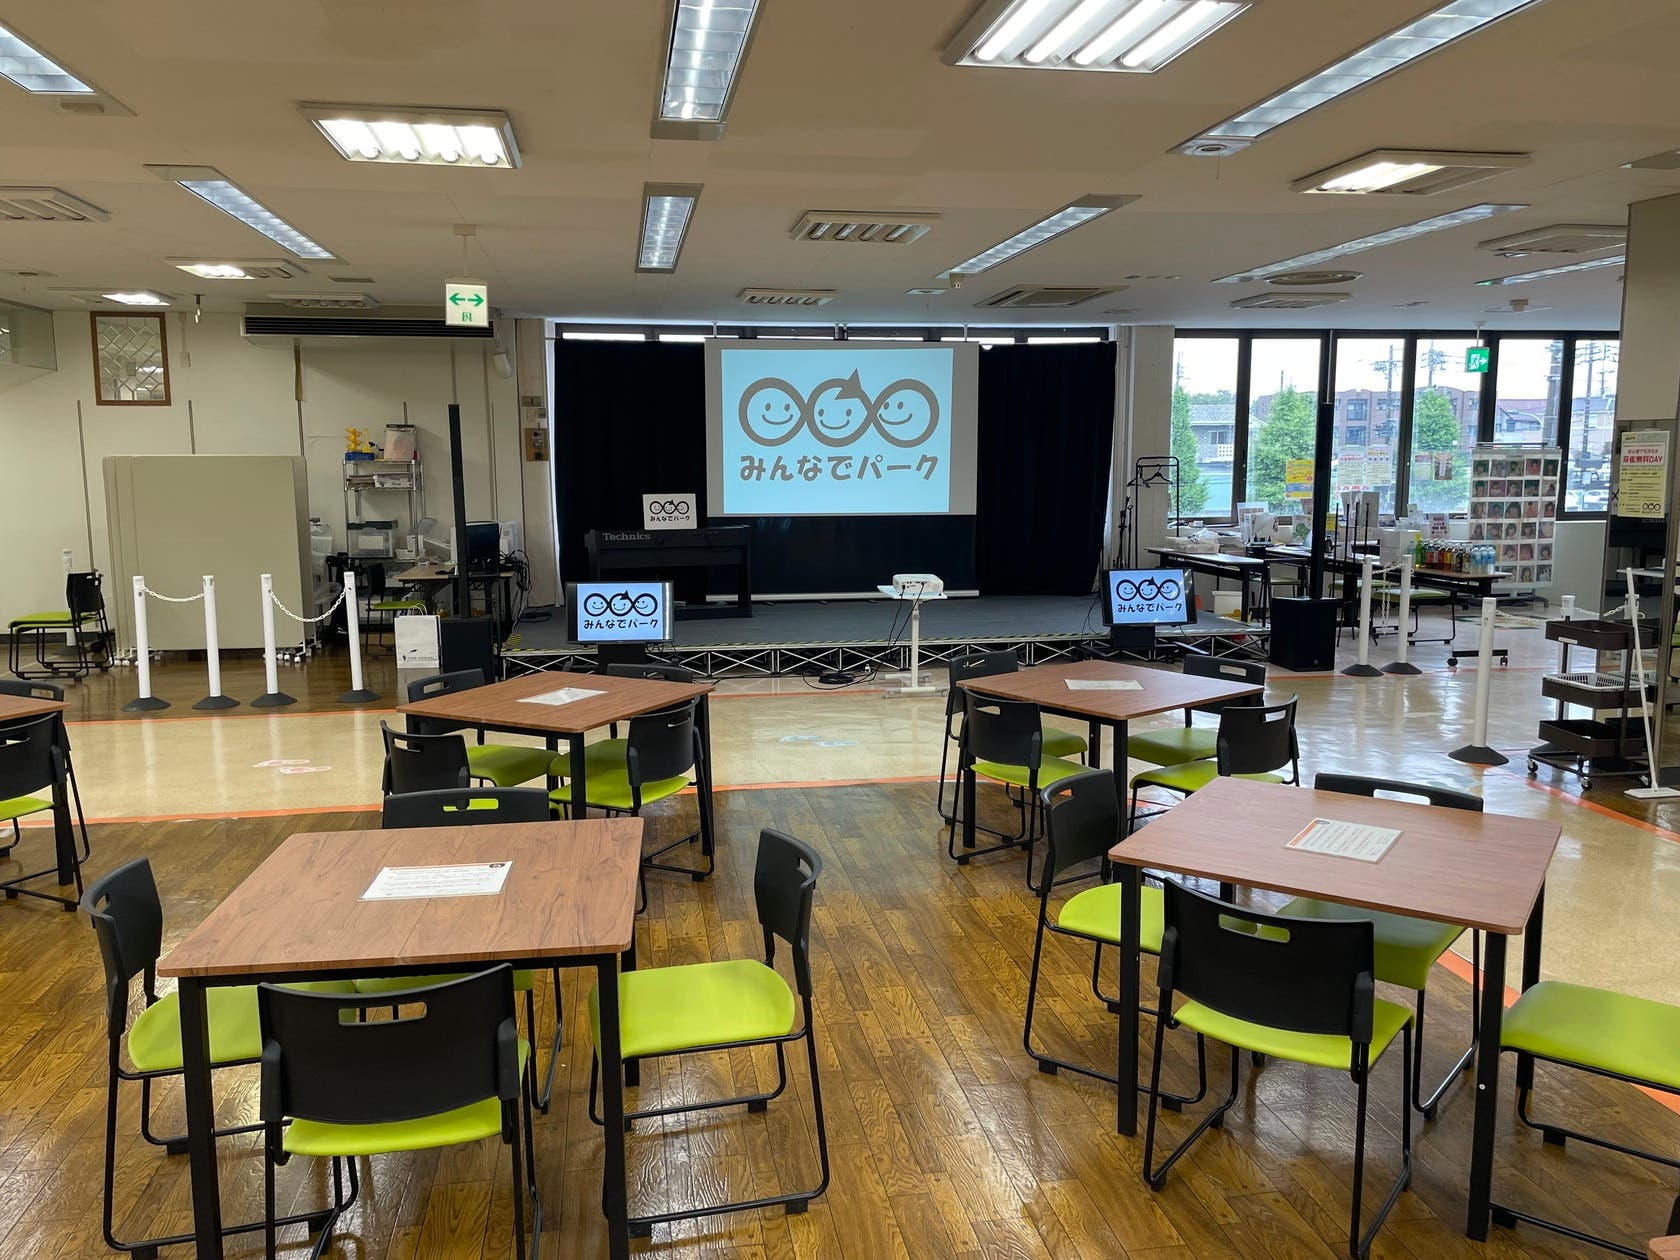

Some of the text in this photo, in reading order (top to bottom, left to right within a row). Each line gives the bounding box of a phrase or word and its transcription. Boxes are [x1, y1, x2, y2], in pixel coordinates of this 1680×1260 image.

[740, 454, 939, 481] みんなでパーク
[602, 532, 651, 541] Technics
[1117, 603, 1182, 613] みんなでパーク
[584, 619, 659, 629] みんなでパーク
